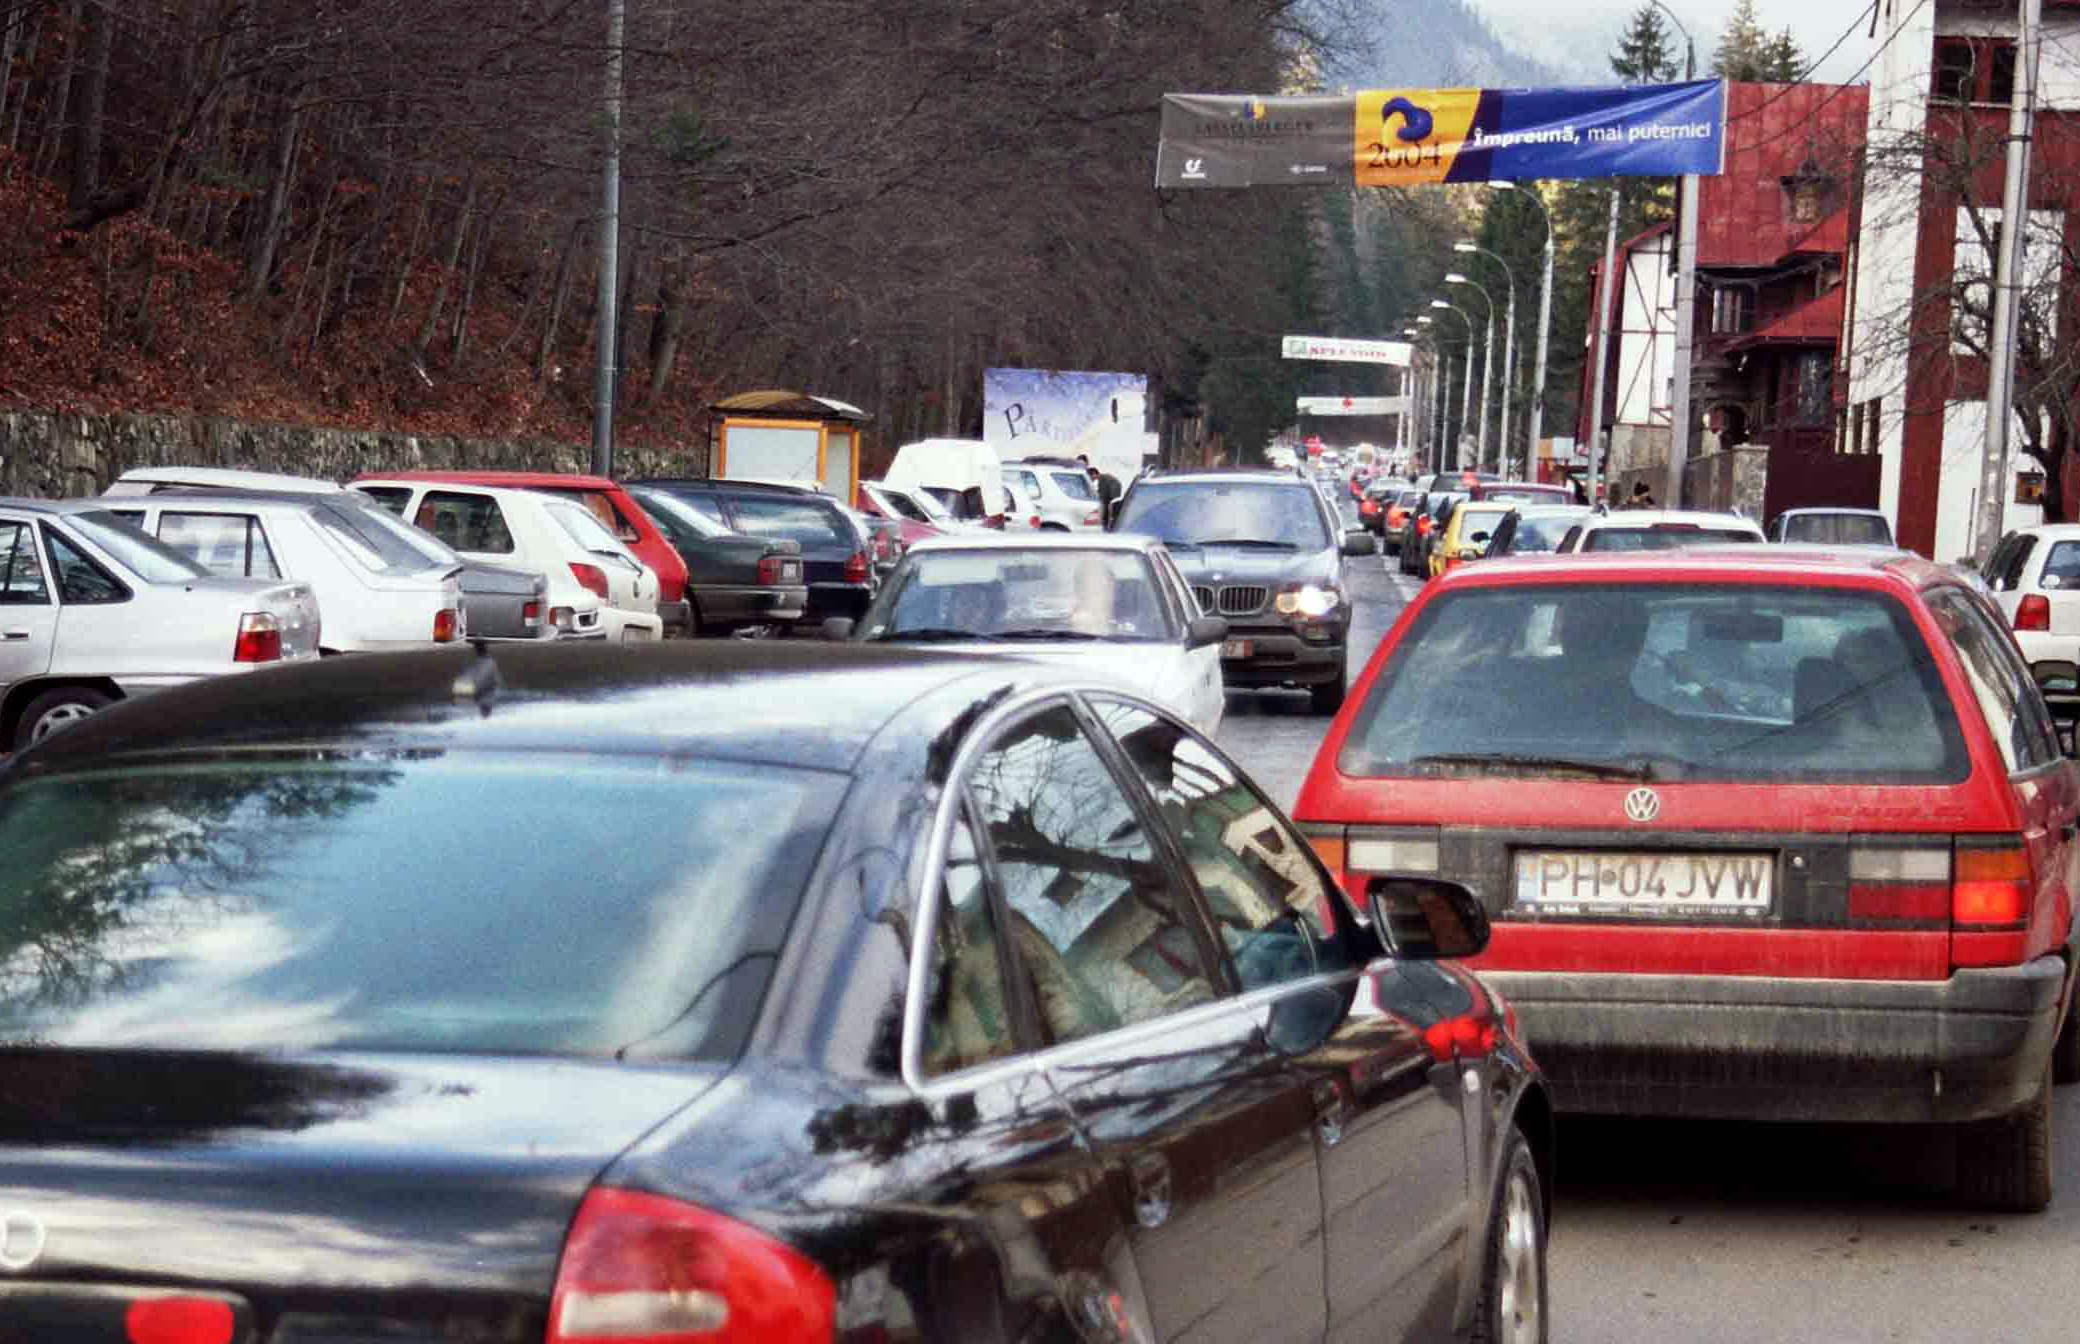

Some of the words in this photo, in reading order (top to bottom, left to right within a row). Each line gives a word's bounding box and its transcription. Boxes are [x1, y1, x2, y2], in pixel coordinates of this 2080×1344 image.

[1588, 123, 1621, 141] mai
[1628, 120, 1711, 144] puternici
[1363, 140, 1442, 169] 2004
